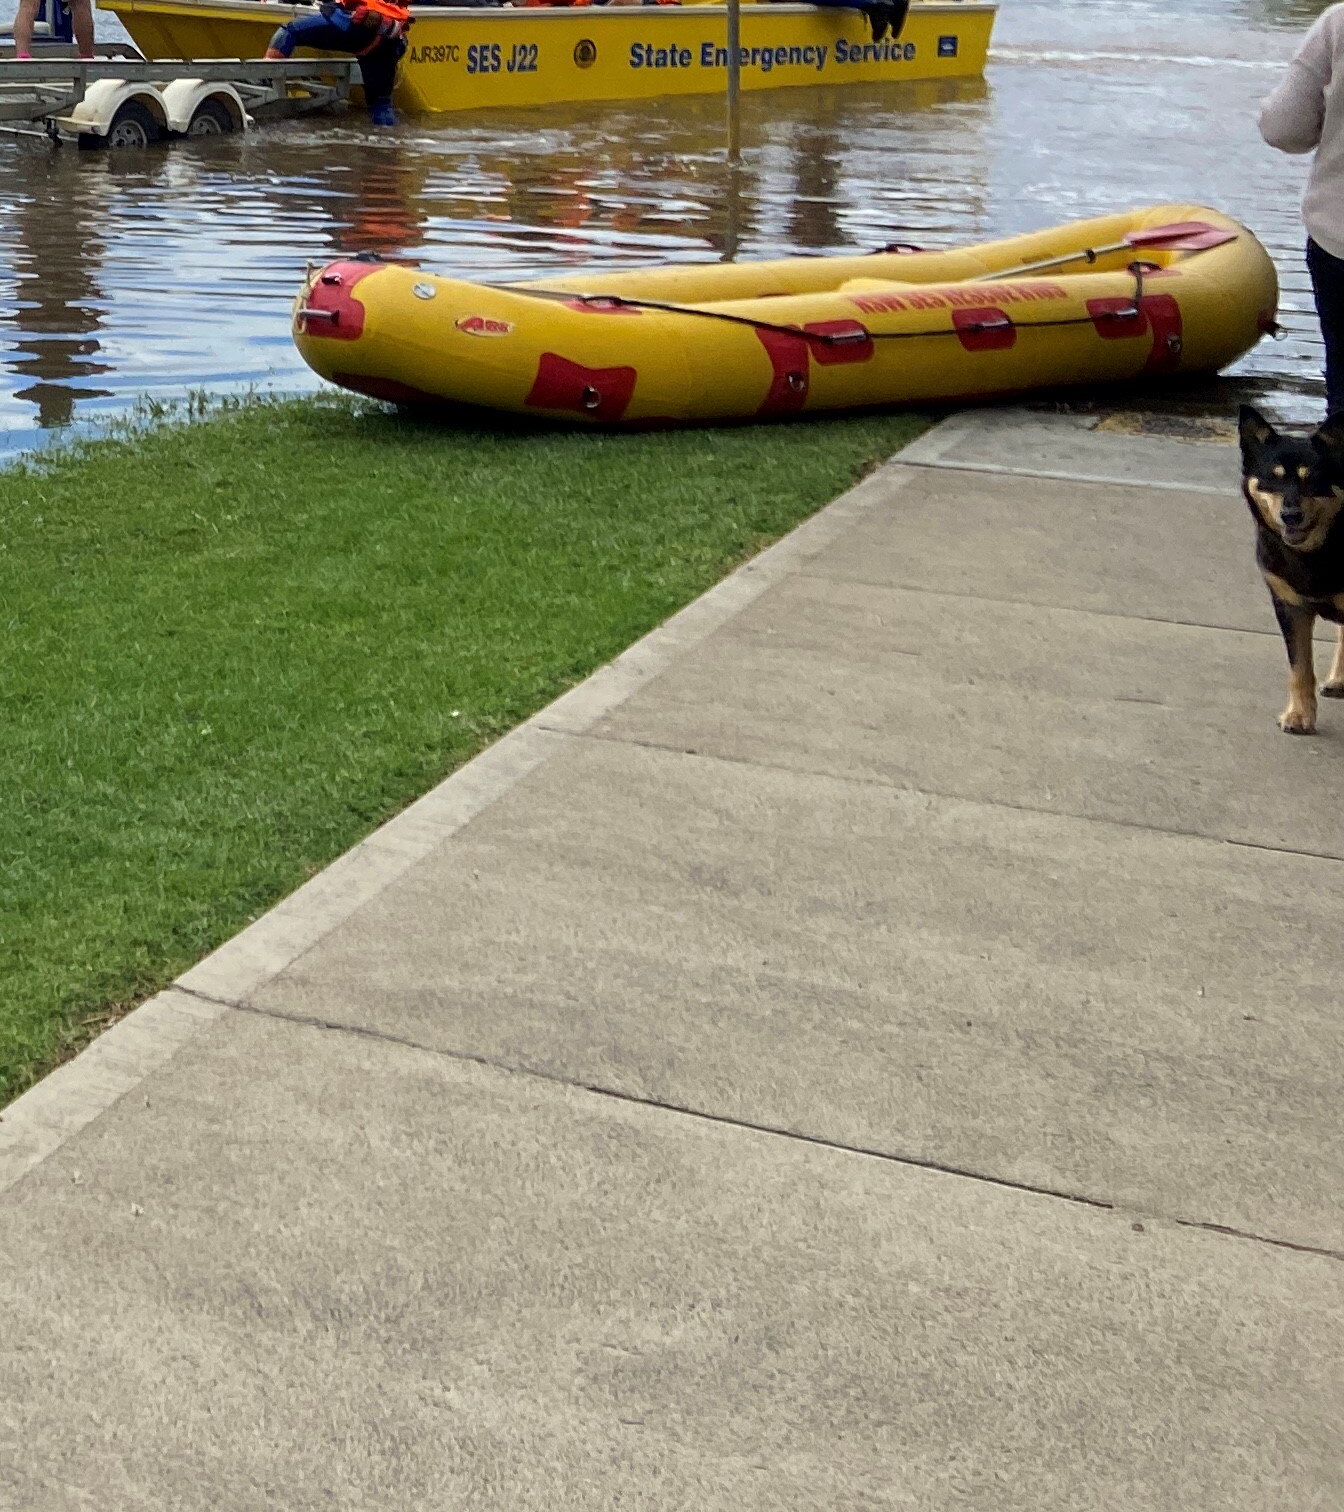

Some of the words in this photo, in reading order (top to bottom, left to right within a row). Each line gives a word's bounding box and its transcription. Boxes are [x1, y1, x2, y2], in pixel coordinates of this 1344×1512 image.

[410, 45, 460, 64] AJR397C
[466, 44, 502, 73] SES
[507, 44, 538, 72] J22
[629, 43, 693, 68] State
[835, 39, 916, 63] Service
